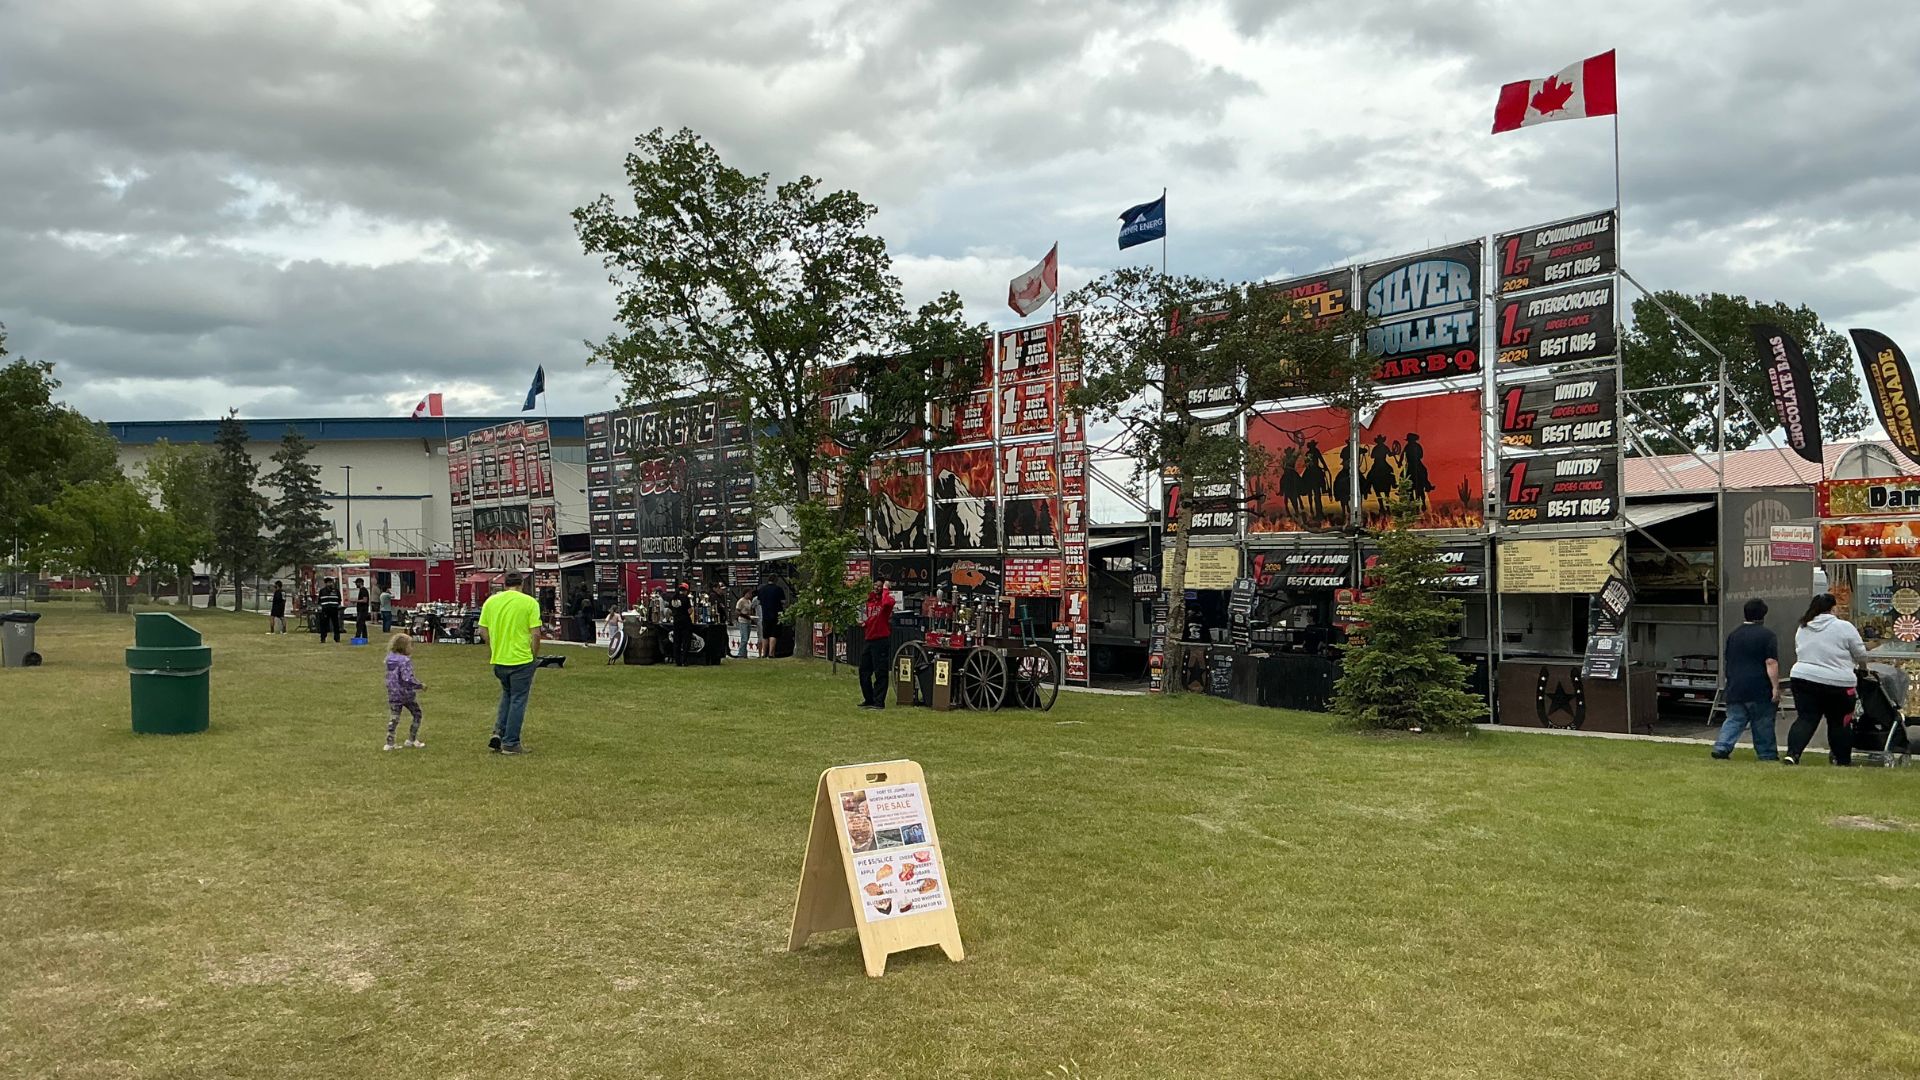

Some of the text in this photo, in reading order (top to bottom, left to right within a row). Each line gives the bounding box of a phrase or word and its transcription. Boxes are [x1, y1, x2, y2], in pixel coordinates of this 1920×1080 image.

[1535, 217, 1610, 247] BOWMANVILLE
[1503, 237, 1531, 276] 1ST
[1544, 256, 1600, 282] BEST RIBS
[1367, 260, 1472, 318] SILVER
[1503, 278, 1529, 291] 2024
[1528, 288, 1609, 317] PETERBOROUGH
[1501, 303, 1531, 345] 1ST
[1367, 311, 1473, 356] BULLET
[1027, 342, 1047, 355] BEST
[1540, 332, 1596, 358] BEST RIBS
[1025, 353, 1049, 366] SAUCE
[1499, 349, 1529, 363] 2024
[1554, 381, 1597, 401] WHITBY
[1769, 336, 1806, 450] CHOCOLATE BARS
[1026, 398, 1046, 410] BEST
[1504, 387, 1535, 430] 1ST
[1575, 403, 1599, 415] CHOICE
[964, 407, 982, 419] BEST
[1023, 408, 1048, 420] SAUCE
[962, 418, 984, 430] SAUCE
[1542, 420, 1612, 444] BEST SAUCE
[1501, 434, 1533, 446] 2024
[1027, 459, 1047, 471] BEST
[1556, 458, 1601, 477] WHITBY
[1025, 471, 1050, 482] SAUCE
[1063, 469, 1082, 478] SAUCE
[1508, 462, 1539, 503] 1ST
[1578, 480, 1604, 492] CHOICE
[1548, 497, 1610, 518] BEST RIBS
[1191, 512, 1234, 528] BEST RIBS
[1507, 508, 1537, 521] 2024
[1837, 538, 1861, 547] Deep
[1864, 536, 1891, 545] Fried
[1065, 545, 1084, 555] BEST
[1065, 555, 1084, 565] RIBS
[1264, 563, 1281, 571] 2024
[1286, 576, 1346, 586] BEST CHICKEN
[877, 800, 911, 812] PIE SALE
[921, 893, 941, 901] WHIPPED
